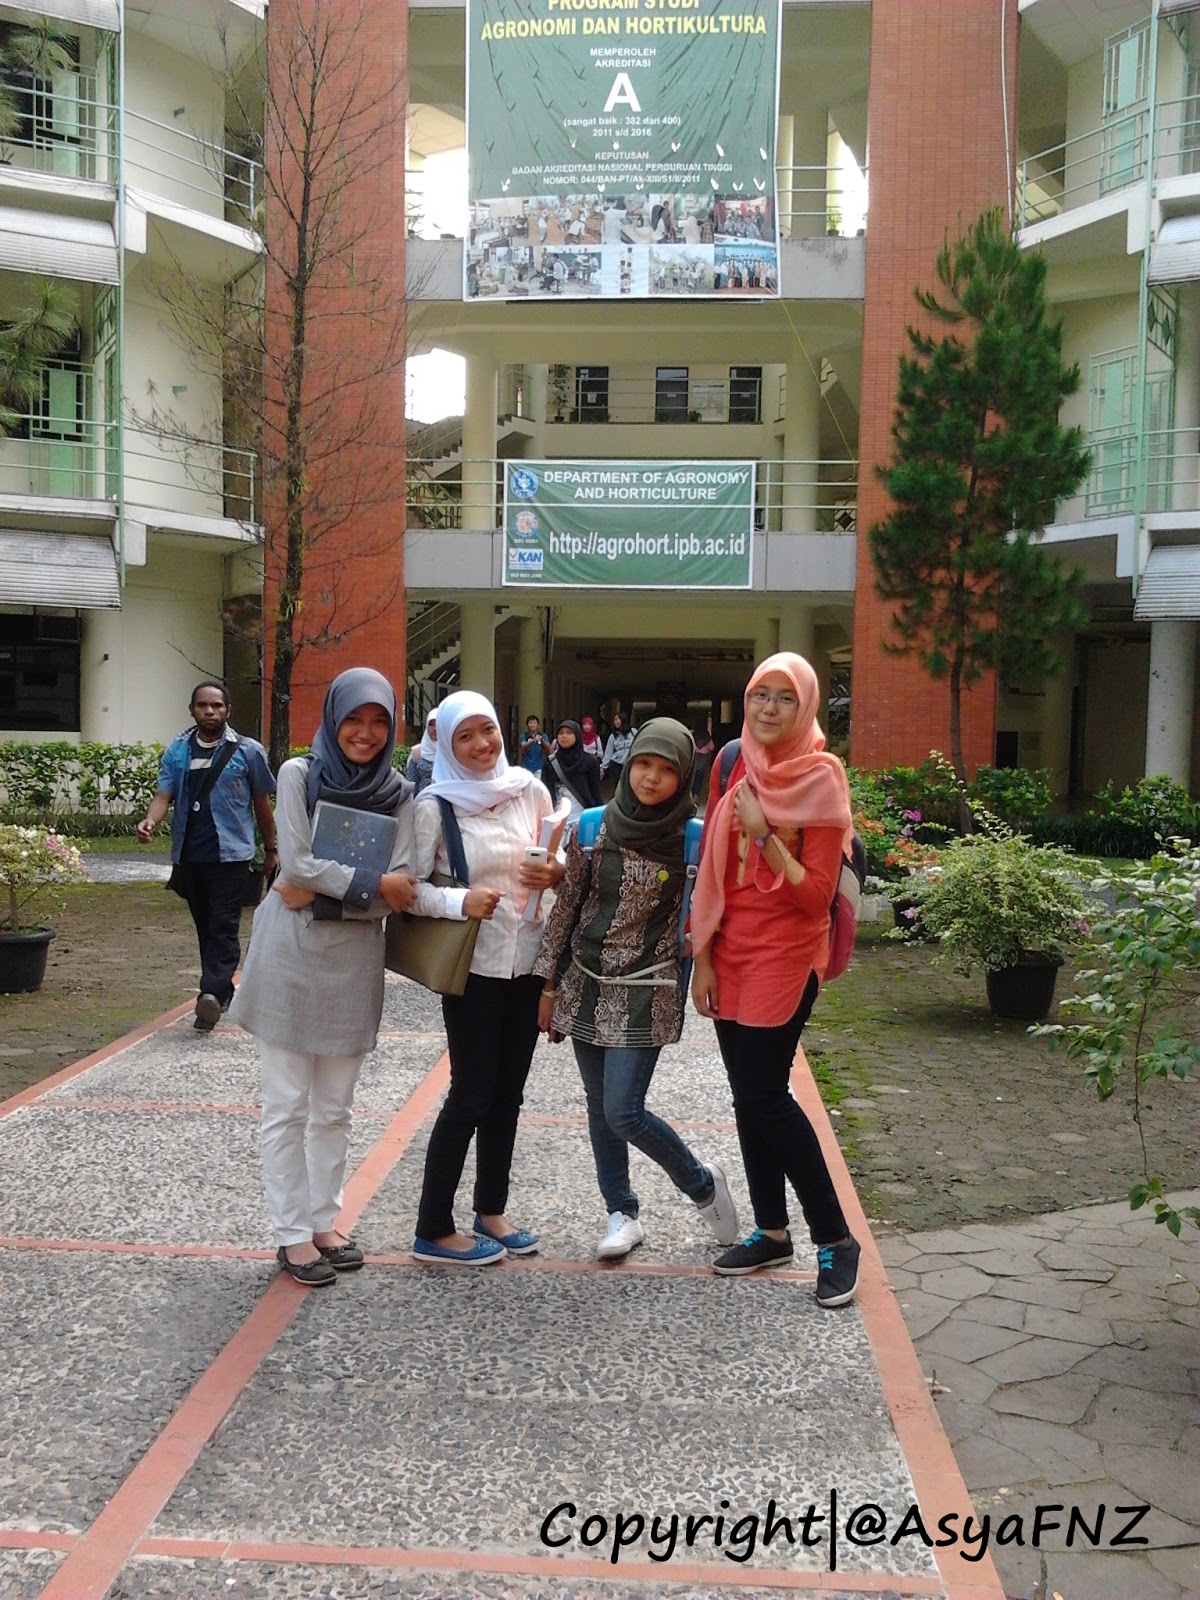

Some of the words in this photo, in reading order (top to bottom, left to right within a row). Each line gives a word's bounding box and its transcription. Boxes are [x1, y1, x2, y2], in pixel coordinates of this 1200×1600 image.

[481, 18, 576, 40] AGRONOMI
[582, 17, 620, 34] DAN
[625, 15, 767, 34] HORTIKULTURA
[590, 48, 656, 56] MEMPEROLEH
[595, 59, 651, 67] AKREDITASI
[603, 72, 642, 112] A
[563, 116, 597, 127] (sangat
[598, 117, 617, 125] baik
[625, 116, 640, 125] 382
[643, 116, 660, 125] dari
[662, 116, 681, 126] 400)
[592, 128, 612, 137] 2011
[615, 128, 629, 137] s/d
[631, 128, 652, 137] 2016
[595, 151, 649, 160] KEPUTUSAN
[512, 165, 542, 175] BADAN
[544, 163, 596, 173] AKREDITASI
[598, 163, 643, 172] NASIONAL
[645, 163, 700, 172] PERGURUAN
[702, 163, 732, 172] TINGGI
[543, 176, 579, 185] NOMOR:
[544, 471, 640, 485] DEPARTMENT
[643, 472, 662, 484] OF
[665, 472, 749, 485] AGRONOMY
[574, 487, 605, 499] AND
[608, 488, 717, 500] HORTICULTURE
[549, 531, 745, 560] http://agrohort.ipb.ac.id
[518, 552, 542, 562] KAN
